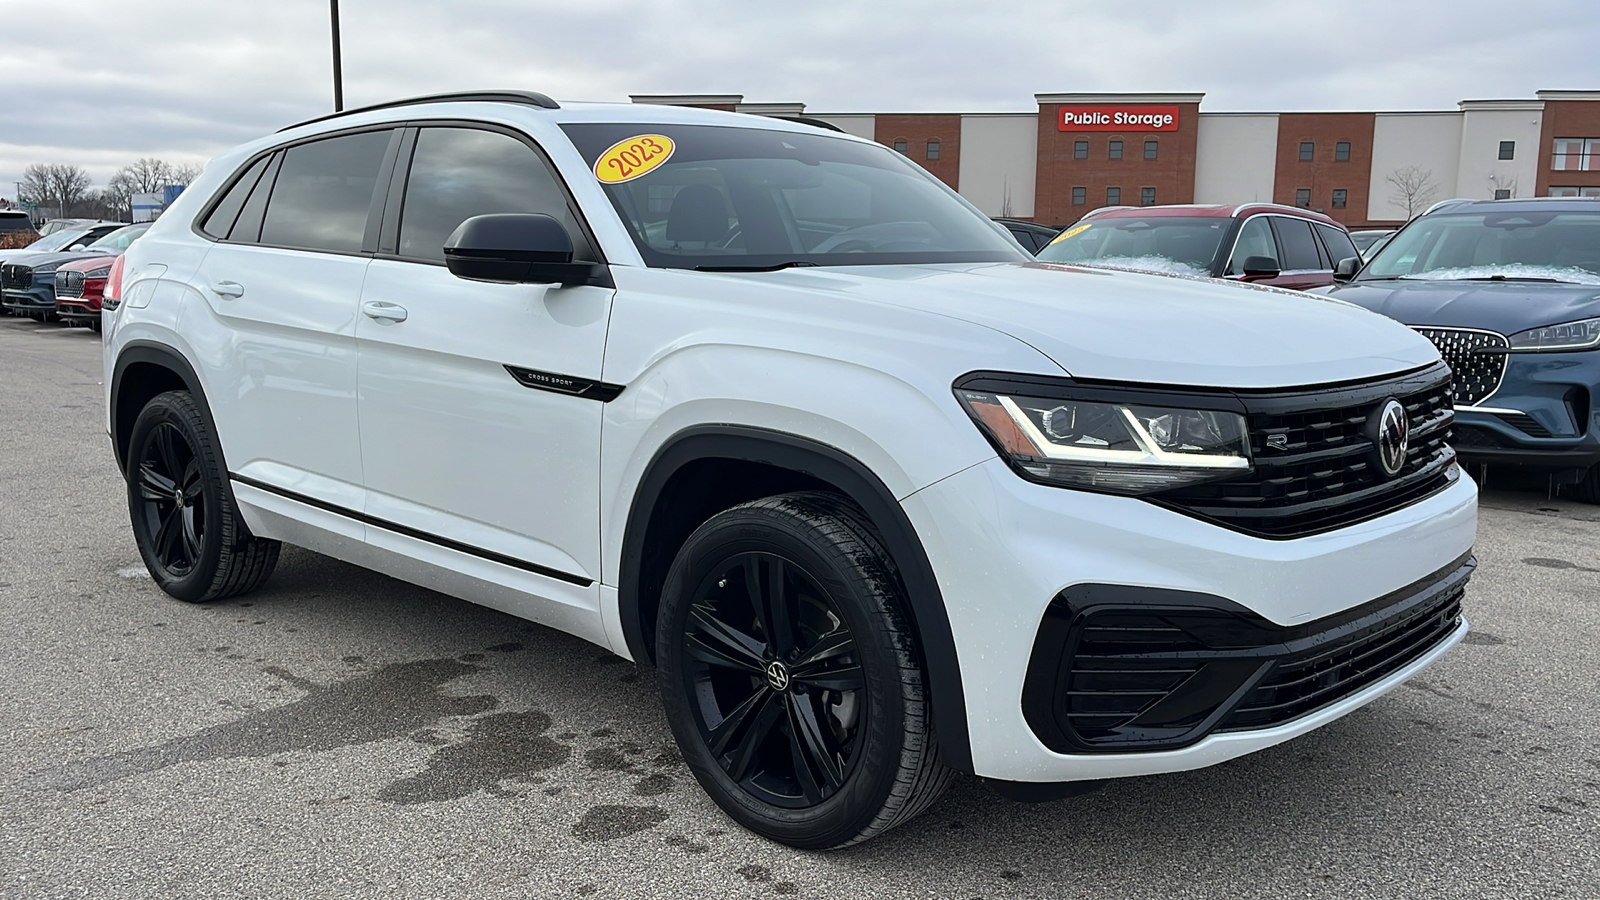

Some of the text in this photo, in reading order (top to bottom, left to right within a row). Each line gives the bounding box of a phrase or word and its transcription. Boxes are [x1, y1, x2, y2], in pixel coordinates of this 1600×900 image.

[1064, 112, 1173, 128] Public Storage
[608, 138, 664, 178] 2023
[528, 373, 573, 386] CROSS SPORT
[1266, 433, 1288, 450] R
